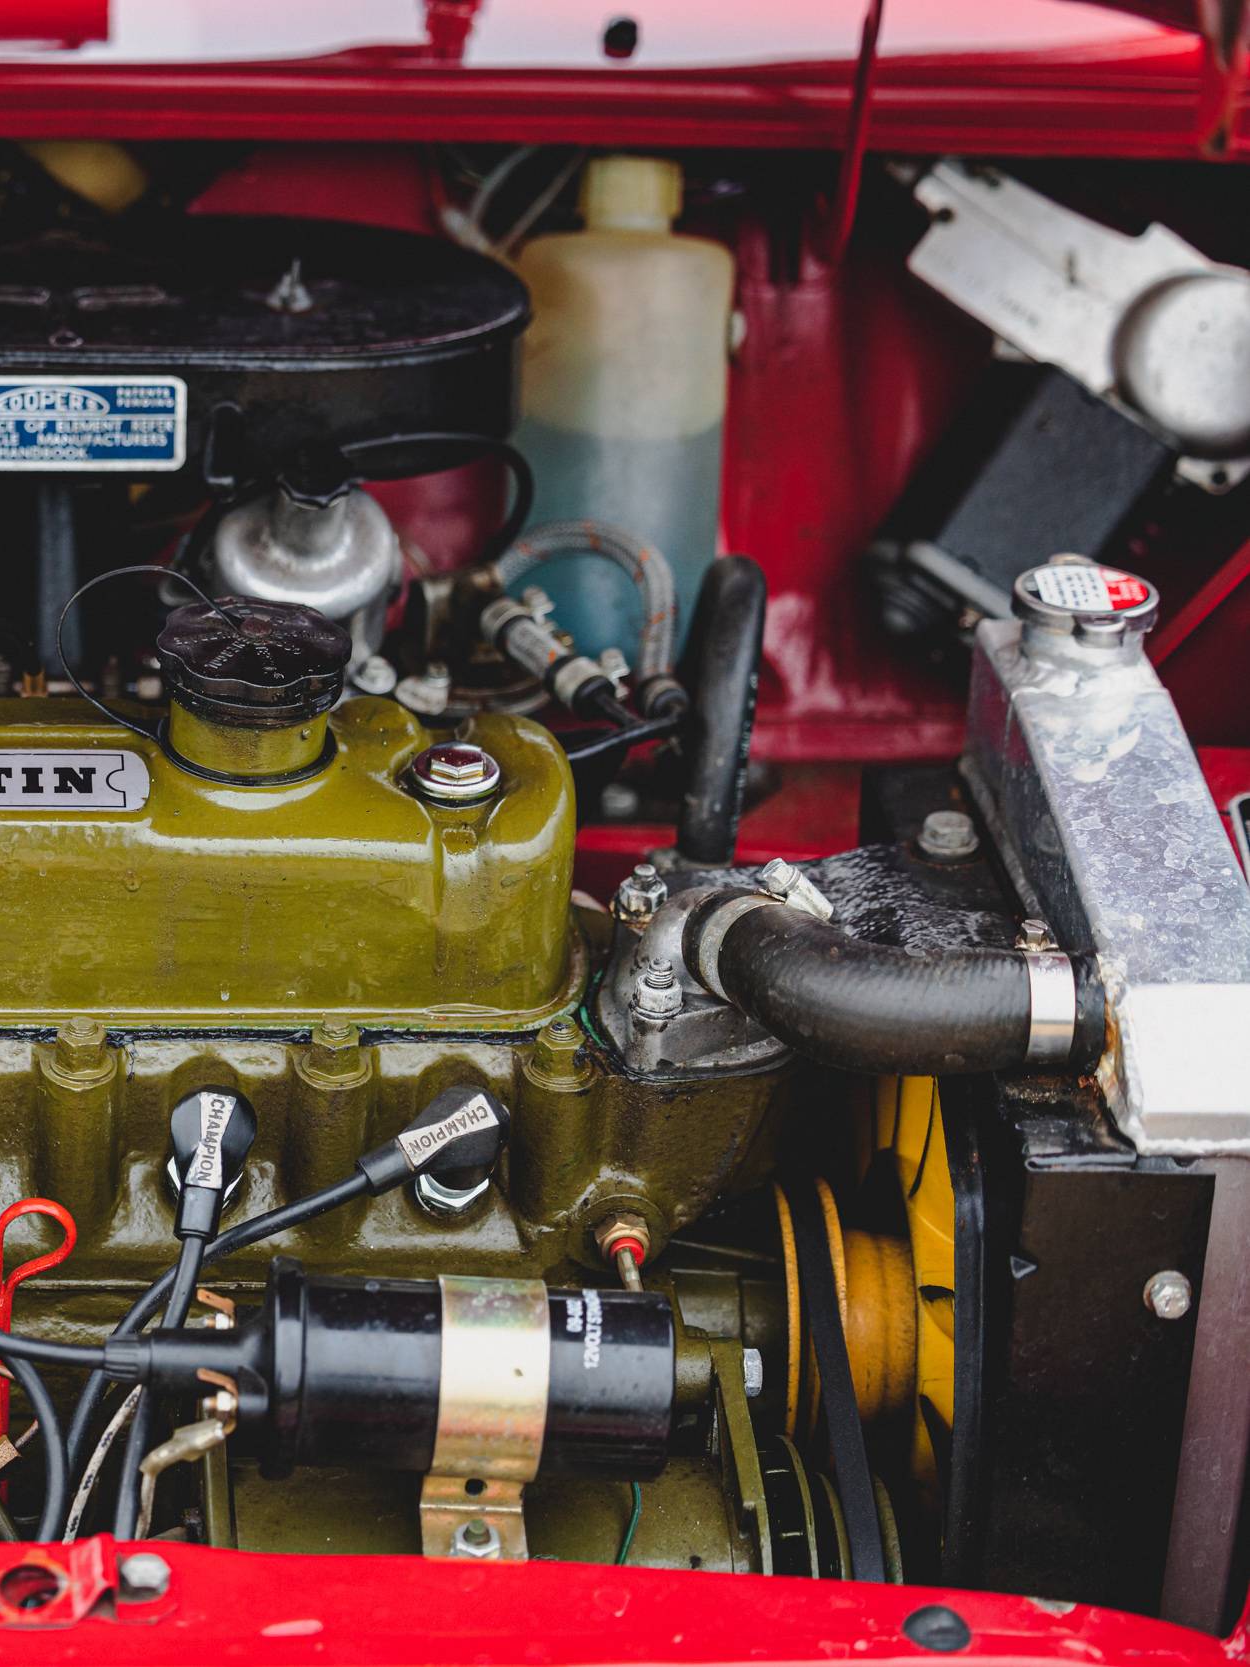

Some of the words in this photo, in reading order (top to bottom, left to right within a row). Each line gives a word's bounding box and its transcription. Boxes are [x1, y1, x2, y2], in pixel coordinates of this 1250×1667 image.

[24, 420, 47, 433] OF
[56, 420, 121, 433] ELEMENT
[131, 420, 174, 432] REFER
[197, 1098, 226, 1183] CHAMPION
[406, 1105, 489, 1156] CHAMPION
